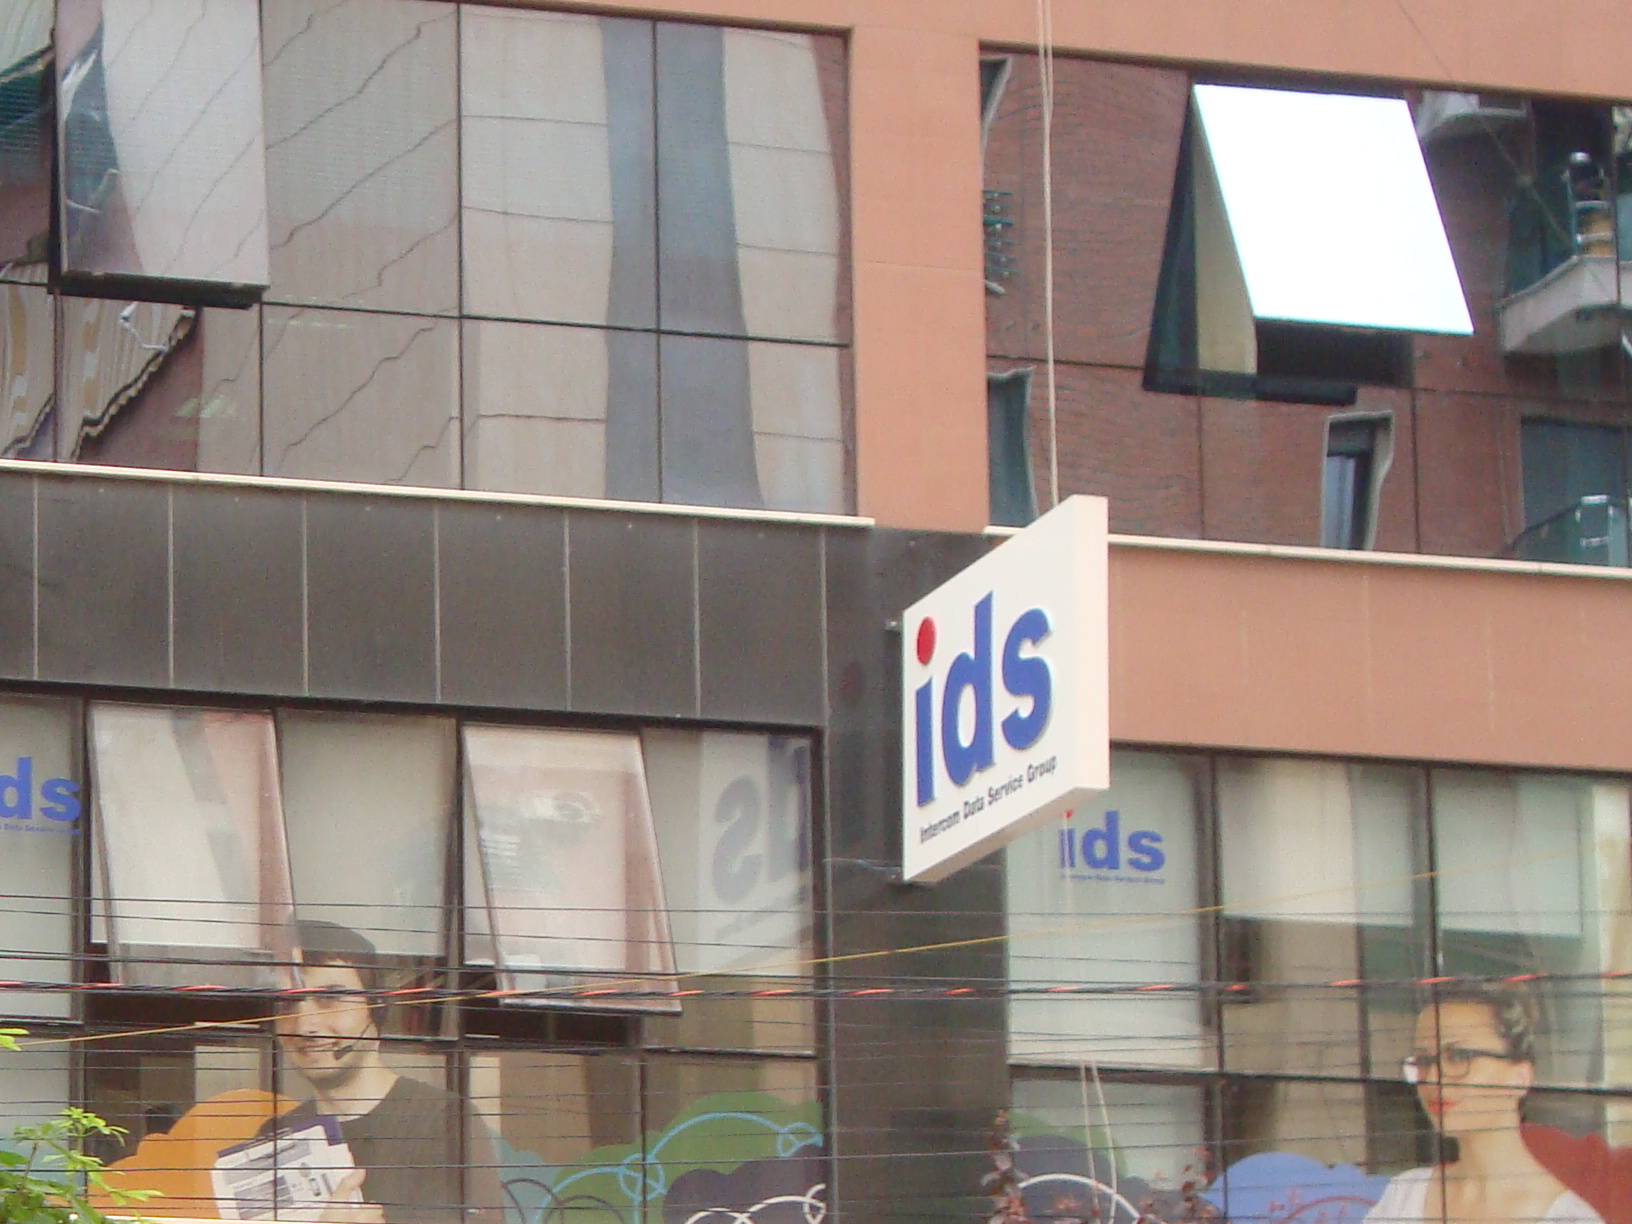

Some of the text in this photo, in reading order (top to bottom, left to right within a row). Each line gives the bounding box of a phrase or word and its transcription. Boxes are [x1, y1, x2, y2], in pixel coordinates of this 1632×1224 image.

[914, 589, 1053, 808] ids
[919, 754, 1056, 844] Intercom Data Service Group
[1058, 809, 1166, 872] ids
